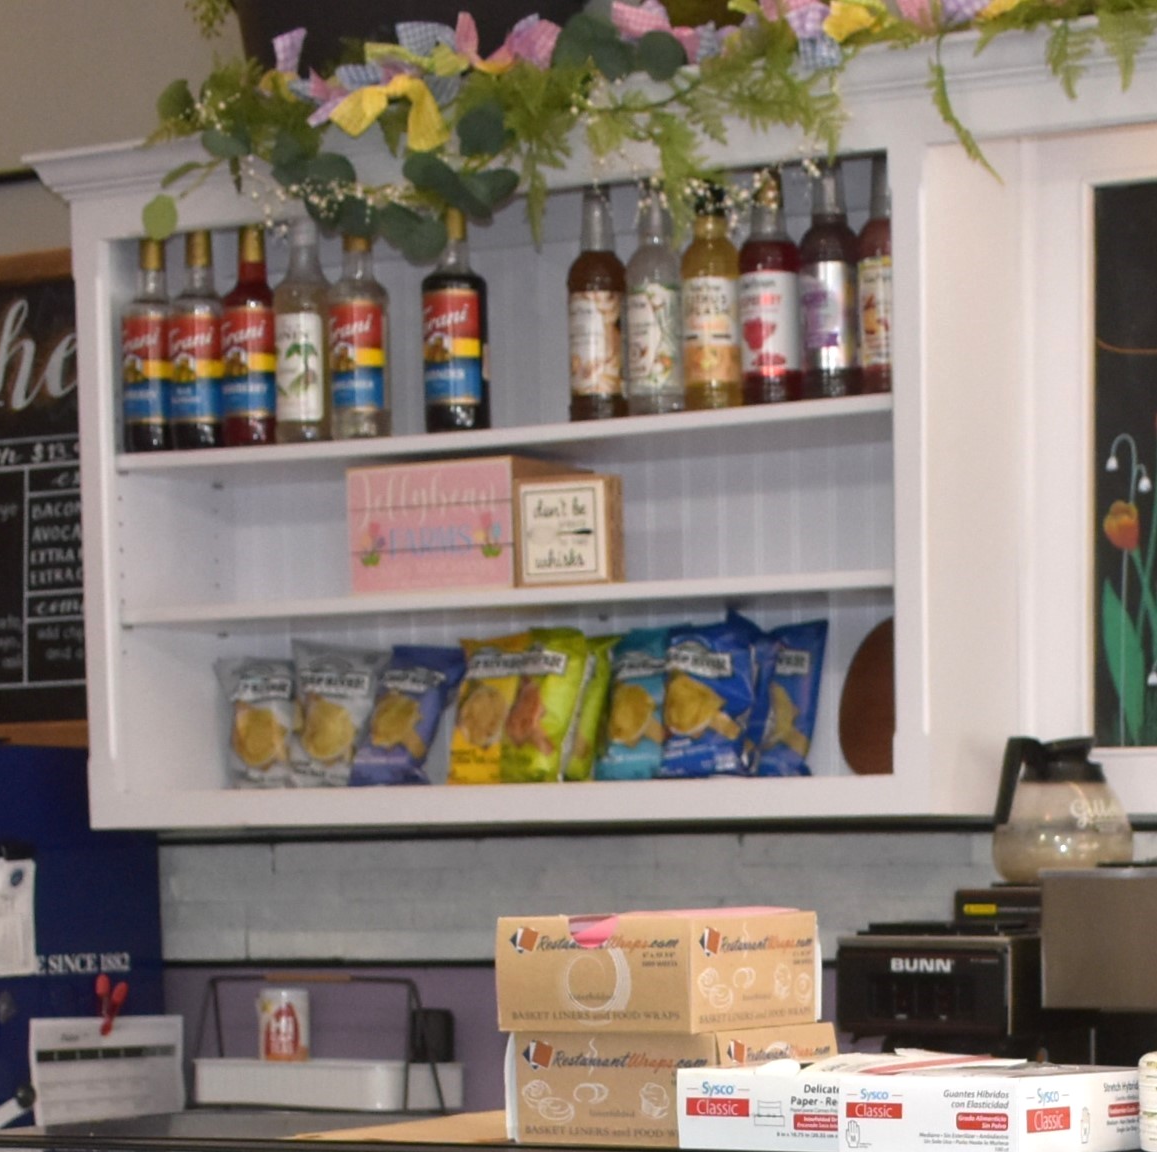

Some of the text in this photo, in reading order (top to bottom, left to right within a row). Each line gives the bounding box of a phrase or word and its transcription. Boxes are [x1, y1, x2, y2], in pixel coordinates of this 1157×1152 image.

[48, 953, 99, 975] SINCE
[891, 957, 952, 973] BUNN
[512, 1009, 551, 1021] BASKET
[701, 1080, 734, 1097] Sysco
[860, 1088, 889, 1101] Sysco
[943, 1088, 975, 1099] Guantes
[791, 1095, 818, 1108] Paper
[1037, 1087, 1060, 1106] Sysco
[696, 1099, 739, 1116] Classic
[854, 1103, 893, 1118] Classic
[966, 1100, 1010, 1110] Elasticidad
[1033, 1110, 1064, 1131] Classic
[525, 1126, 566, 1138] BASKET
[633, 1128, 664, 1141] FOOD
